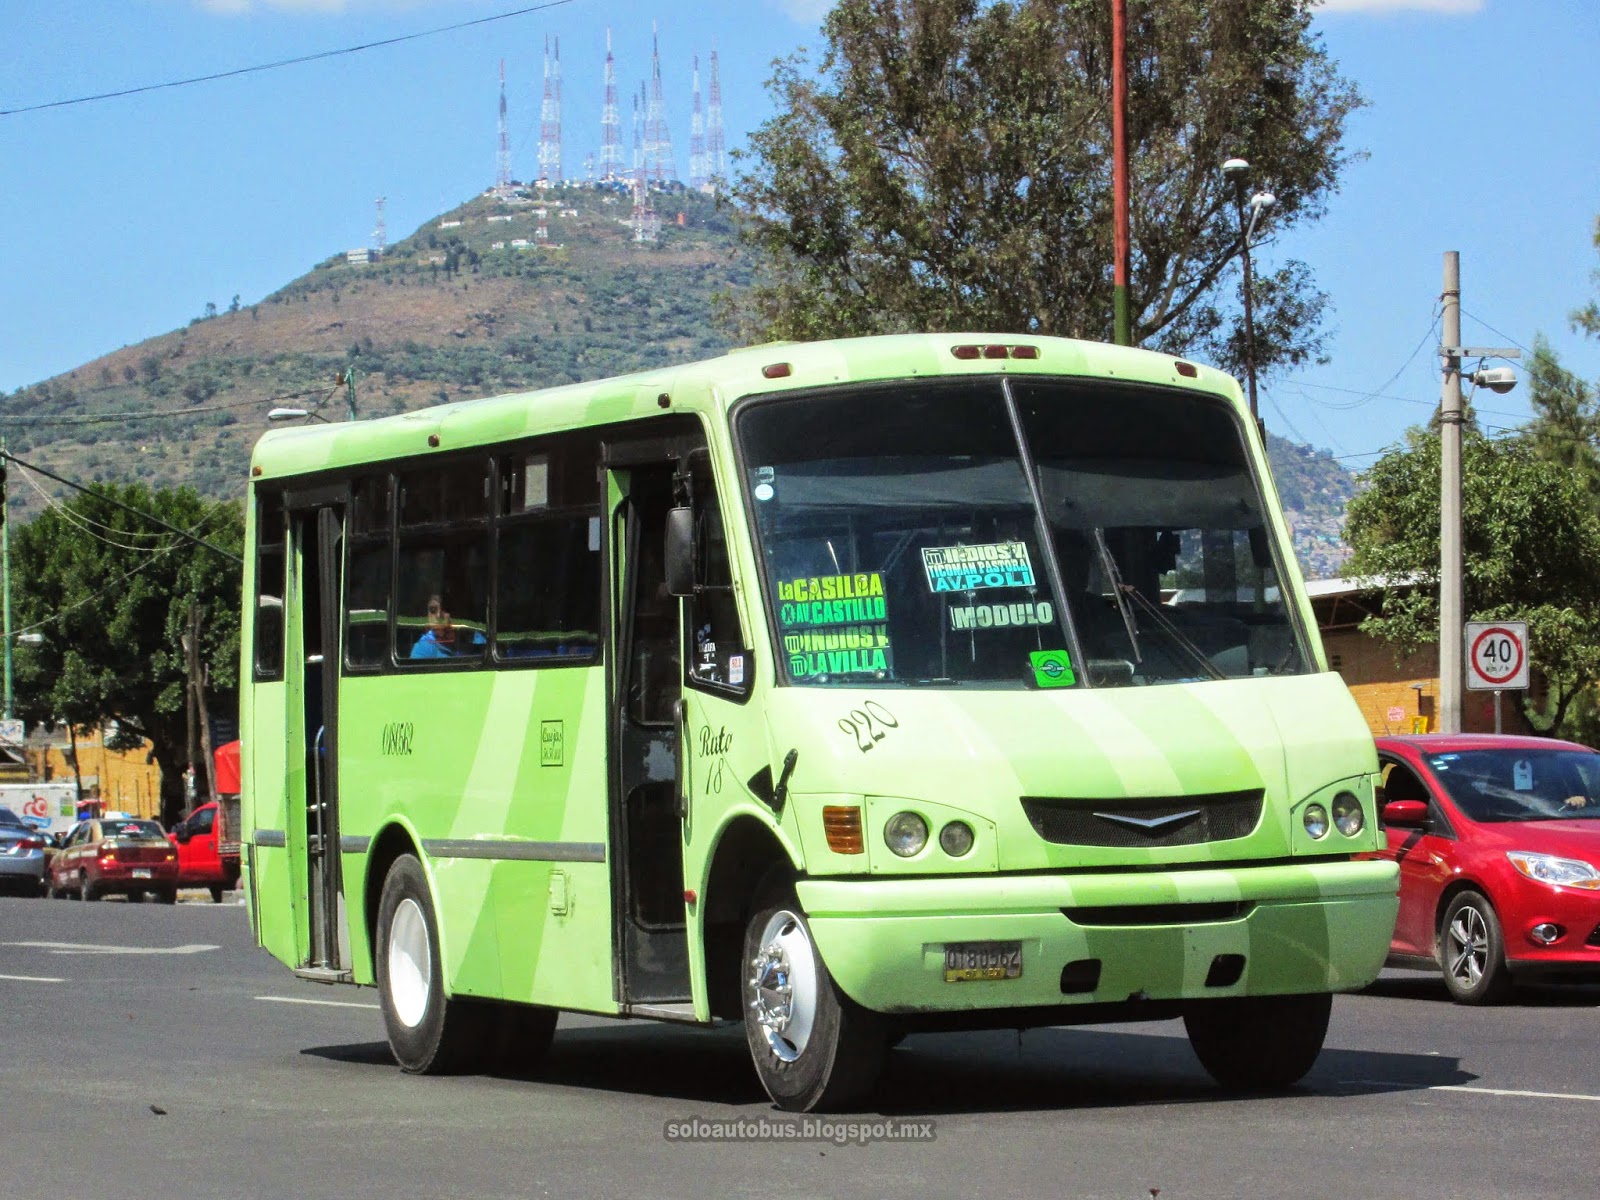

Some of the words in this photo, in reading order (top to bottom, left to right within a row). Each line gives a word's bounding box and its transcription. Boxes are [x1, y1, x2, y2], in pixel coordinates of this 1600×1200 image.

[928, 561, 977, 578] TICOMAN
[977, 558, 1029, 574] PASTORA
[954, 602, 1053, 628] MODULO
[1483, 639, 1511, 662] 40
[699, 725, 733, 757] Ruta
[838, 700, 899, 753] 220
[706, 757, 724, 795] 18
